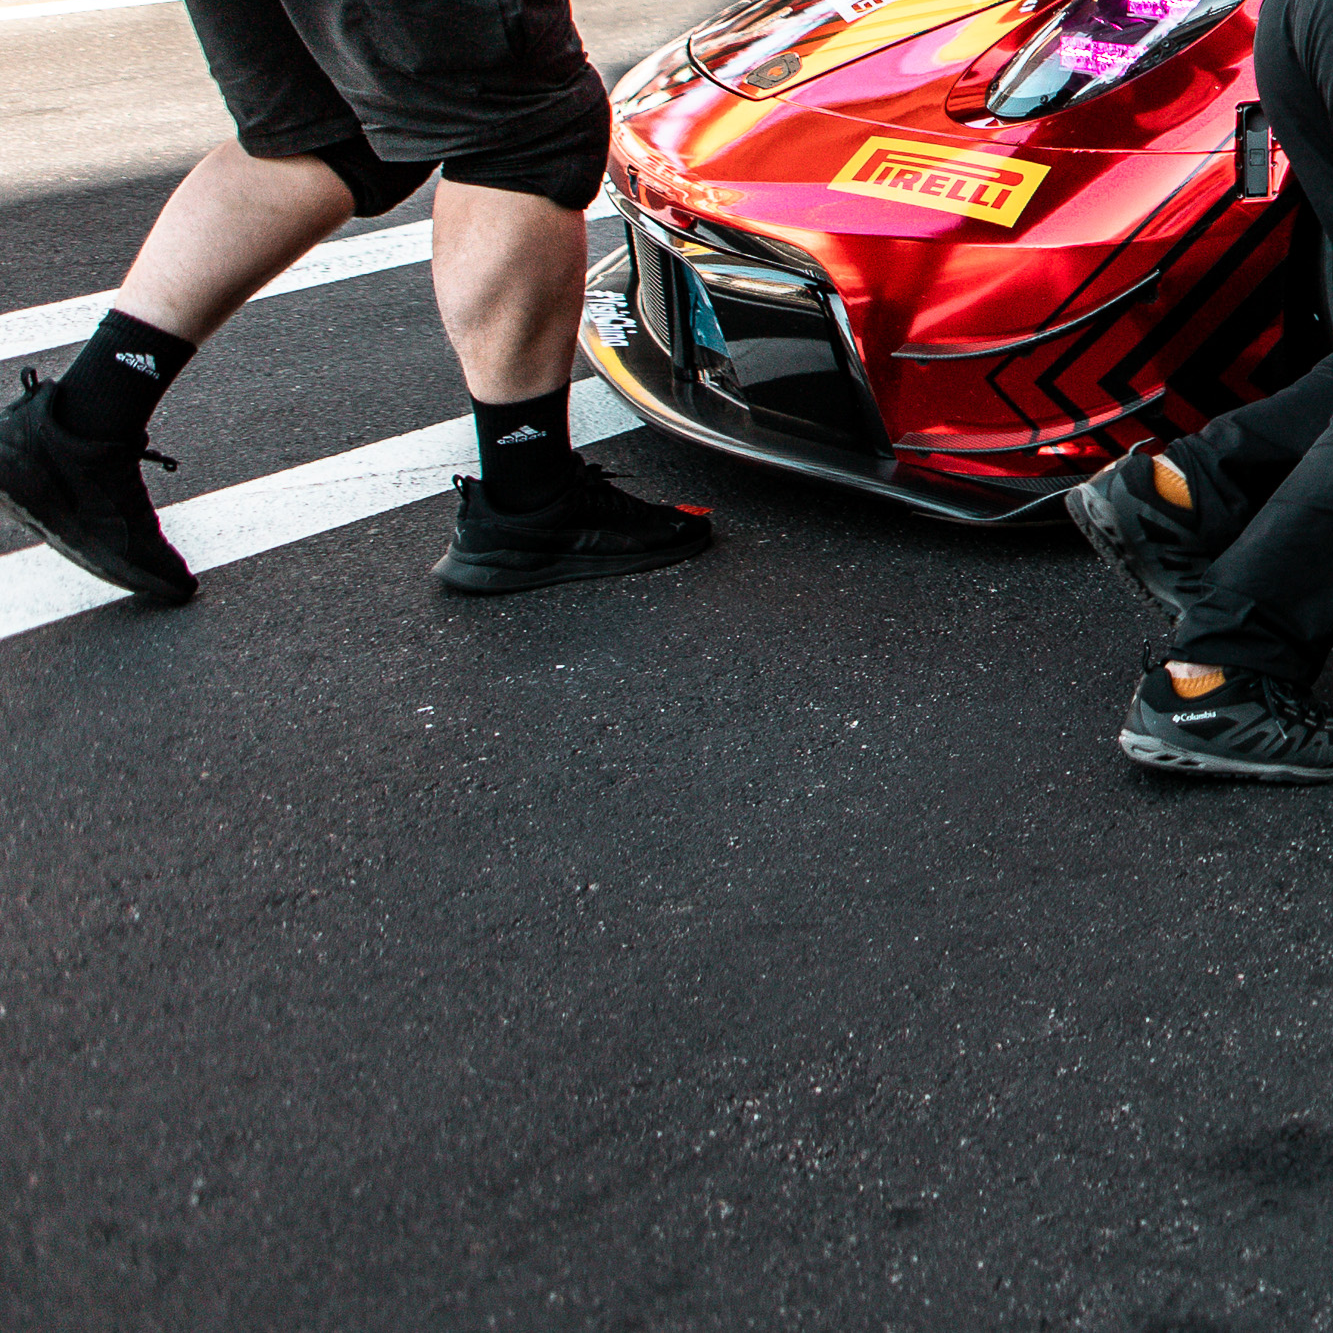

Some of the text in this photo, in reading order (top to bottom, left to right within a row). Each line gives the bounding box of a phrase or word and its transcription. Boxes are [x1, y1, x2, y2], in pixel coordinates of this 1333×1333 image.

[854, 147, 1025, 210] PIRELLI
[584, 289, 638, 348] #VisitChina
[115, 352, 160, 380] adidas
